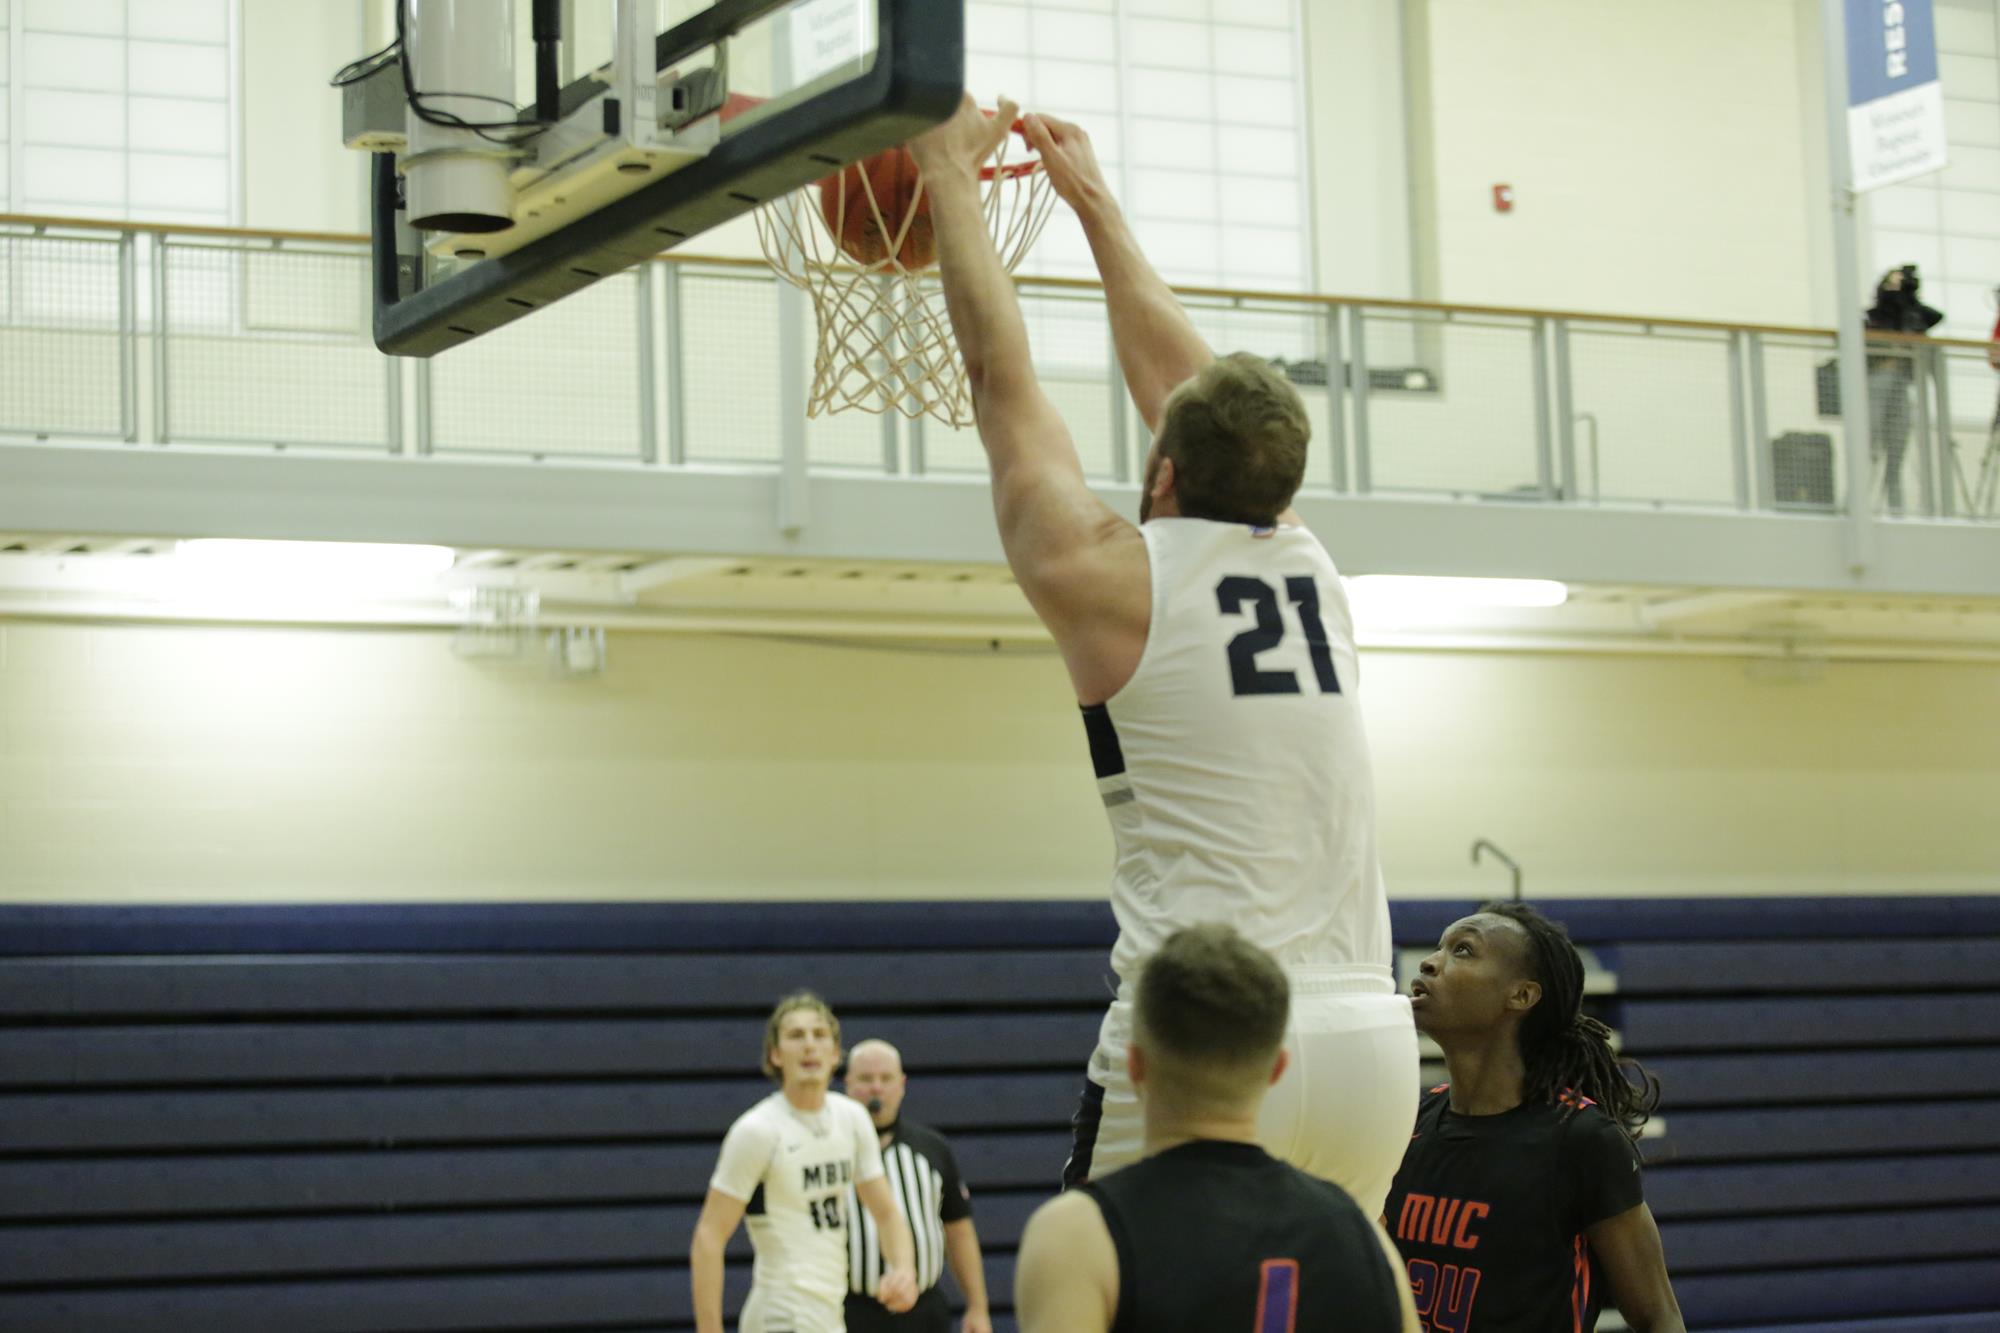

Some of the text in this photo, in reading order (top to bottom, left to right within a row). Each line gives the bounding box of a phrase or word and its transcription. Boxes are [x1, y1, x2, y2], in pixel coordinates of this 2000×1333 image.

[1215, 576, 1342, 696] 21
[1397, 1192, 1490, 1249] MVC
[1407, 1257, 1482, 1333] 24
